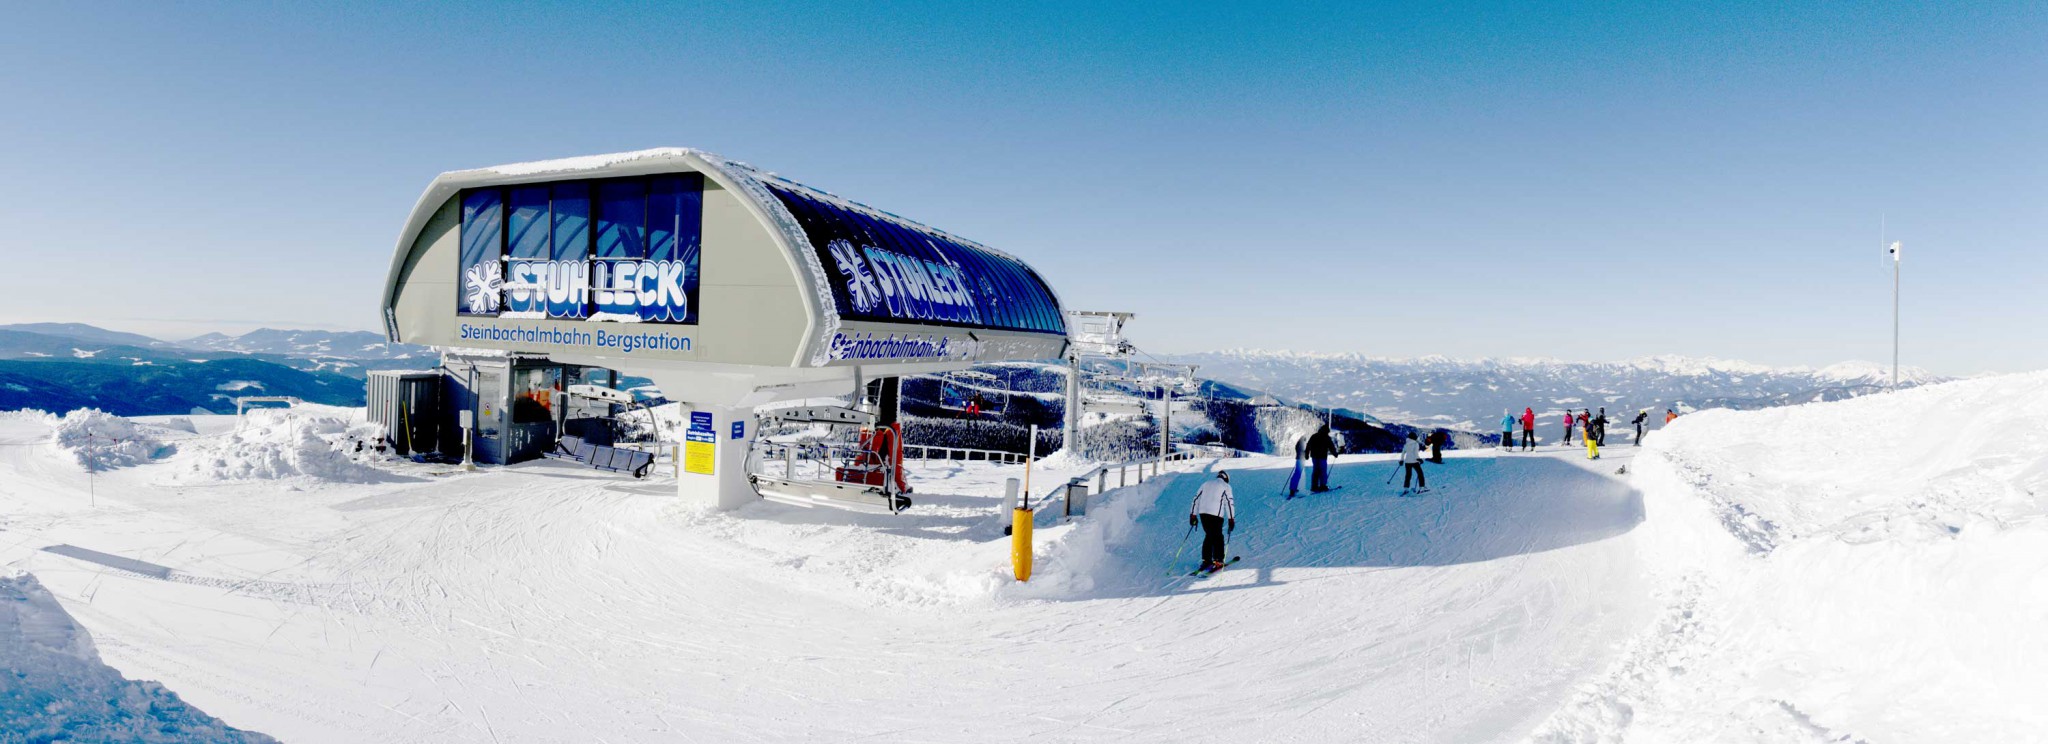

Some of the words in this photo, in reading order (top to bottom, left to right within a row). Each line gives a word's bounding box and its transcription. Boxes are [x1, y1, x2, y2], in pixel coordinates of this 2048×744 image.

[511, 260, 686, 314] STUHLECK
[862, 245, 977, 316] STUHLECK
[460, 323, 592, 346] Steinbachalmbahn
[596, 329, 691, 353] Bergstation
